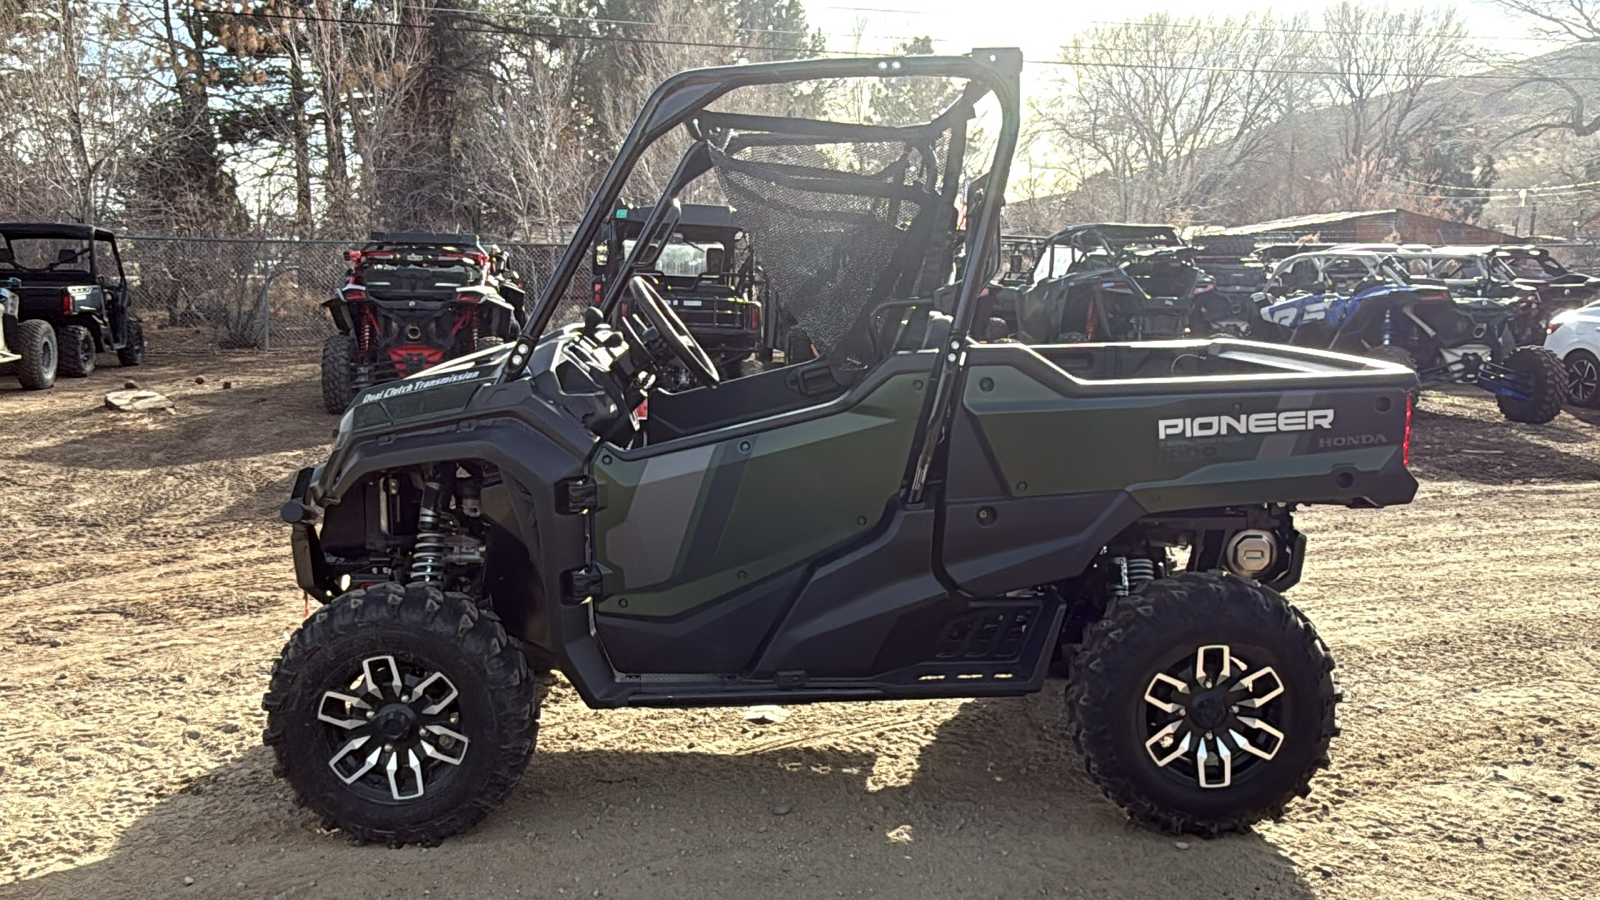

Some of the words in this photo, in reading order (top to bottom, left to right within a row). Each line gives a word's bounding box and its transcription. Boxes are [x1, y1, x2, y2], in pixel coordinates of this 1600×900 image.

[362, 390, 384, 404] Dual
[383, 383, 414, 398] Clutch
[413, 371, 480, 390] Transmission
[1158, 409, 1335, 440] PIONEER
[1318, 433, 1388, 448] HONDA
